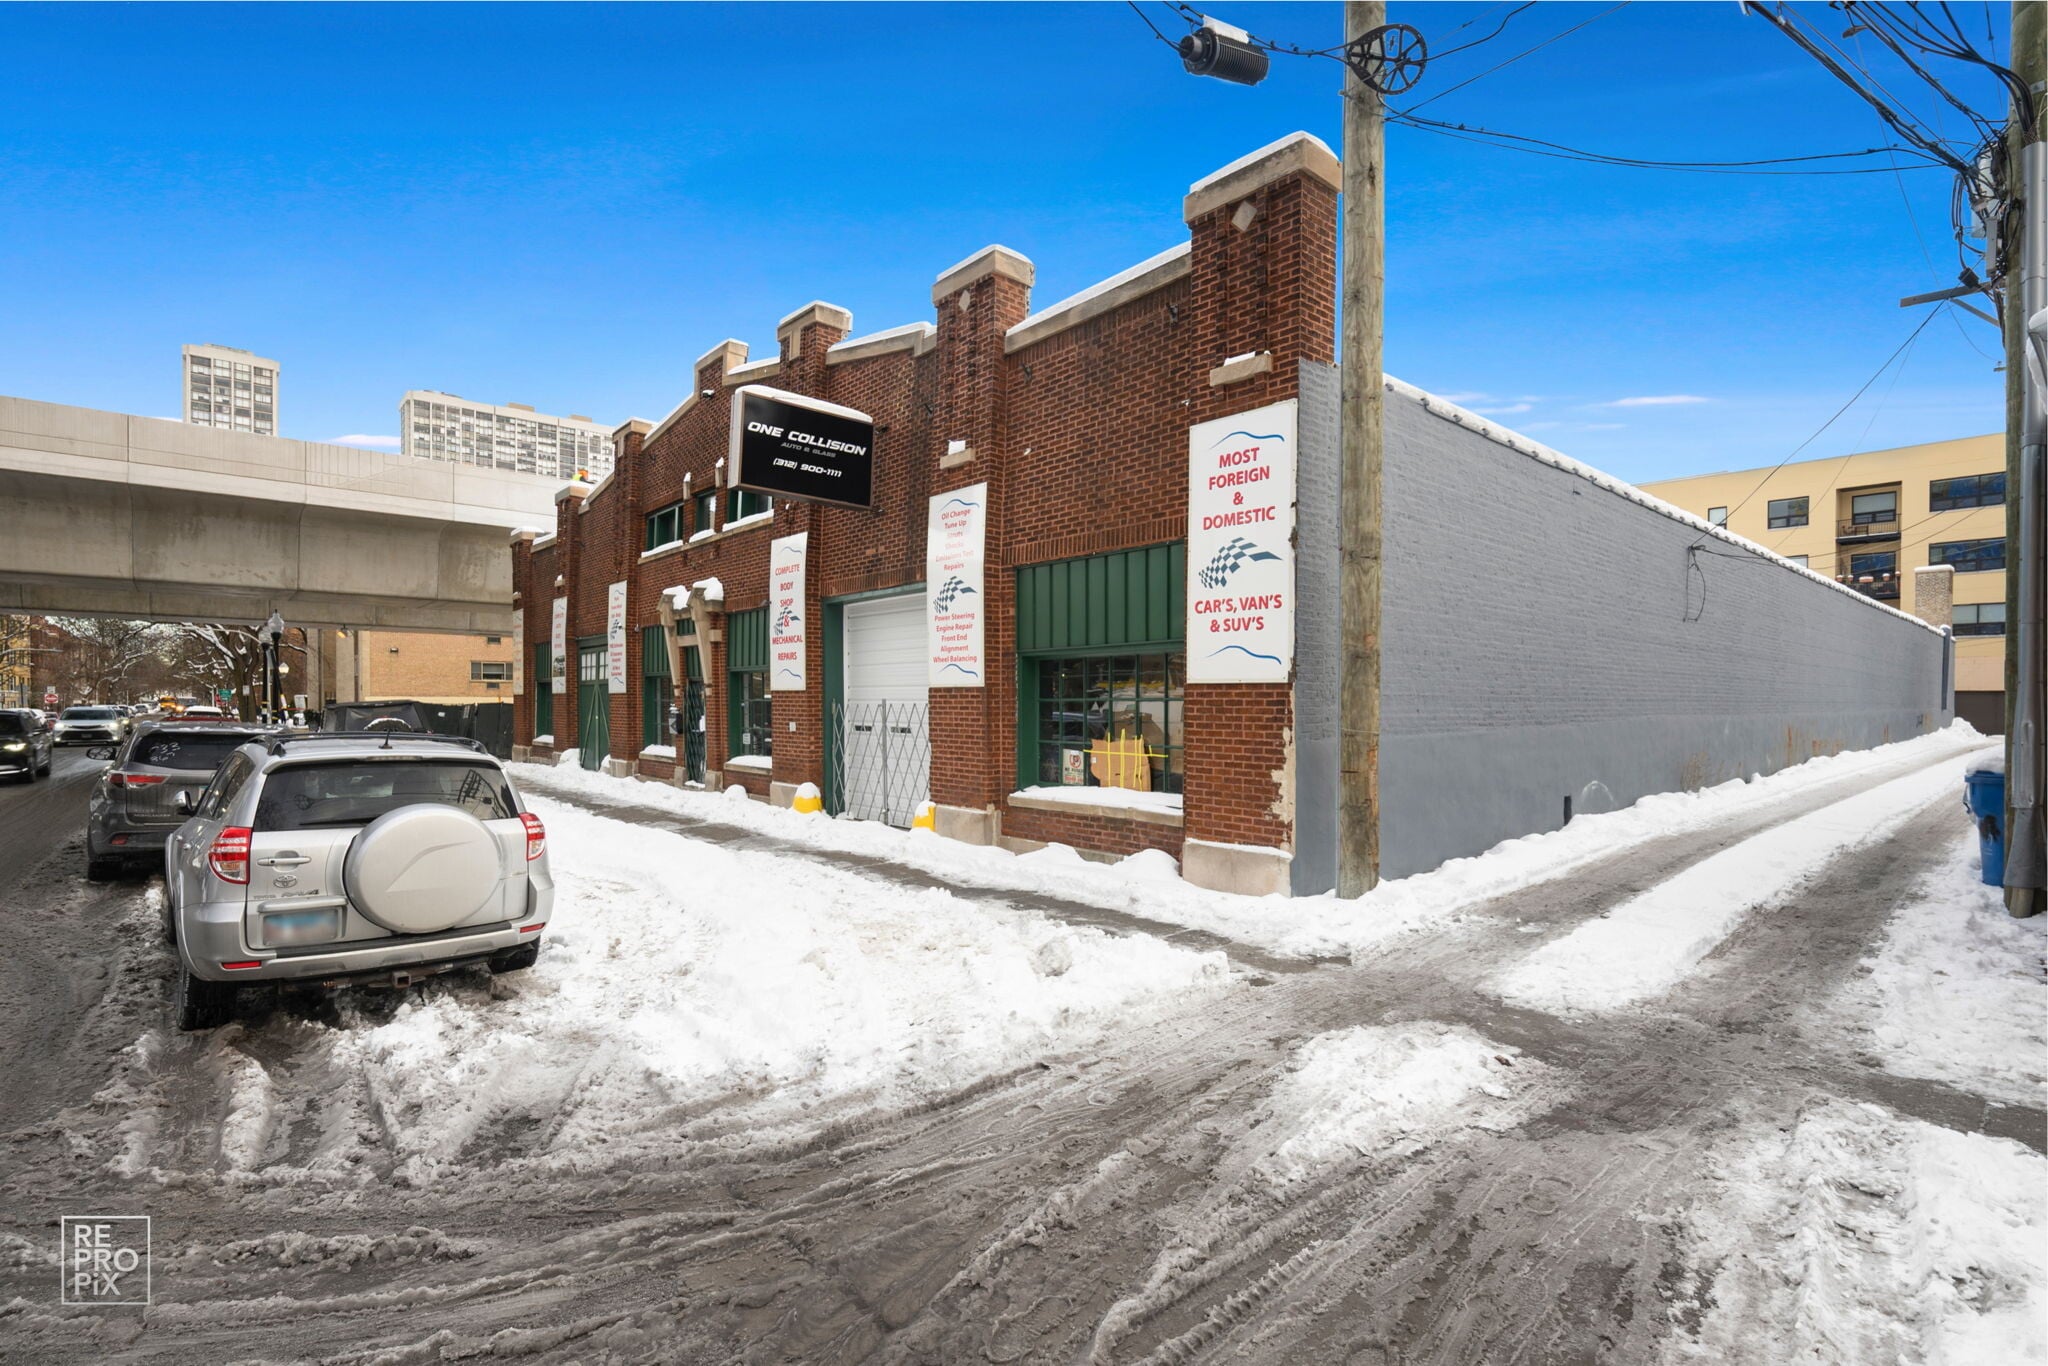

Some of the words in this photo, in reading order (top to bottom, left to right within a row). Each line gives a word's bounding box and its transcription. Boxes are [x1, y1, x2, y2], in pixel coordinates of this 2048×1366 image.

[747, 421, 784, 437] ONE
[788, 430, 867, 456] COLLISION
[781, 442, 802, 451] AUTO
[812, 449, 837, 458] GLASS
[1219, 447, 1260, 468] MOST
[772, 457, 798, 470] (312)
[800, 463, 842, 478] 900-1111
[1208, 466, 1270, 490] FOREIGN
[1232, 491, 1244, 505] &
[941, 511, 949, 520] Oil
[949, 508, 971, 519] Change
[1202, 506, 1276, 531] DOMESTIC
[944, 522, 957, 530] Tune
[958, 520, 967, 529] Up
[775, 563, 801, 576] COMPLETE
[943, 562, 965, 572] Repairs
[780, 581, 794, 592] BODY
[779, 599, 794, 608] SHOP
[1194, 599, 1237, 615] CAR'S,
[1239, 594, 1283, 611] VAN'S
[783, 615, 790, 627] &
[934, 613, 950, 622] Power
[951, 611, 975, 622] Steering
[936, 623, 953, 633] Engine
[954, 622, 973, 632] Repair
[1210, 619, 1221, 633] &
[1223, 616, 1265, 632] SUV'S
[772, 634, 803, 645] MECHANICAL
[941, 634, 956, 642] Front
[956, 633, 968, 641] End
[940, 644, 969, 654] Alignment
[777, 651, 798, 661] REPAIRS
[933, 655, 950, 663] Wheel
[950, 654, 978, 665] Balancing
